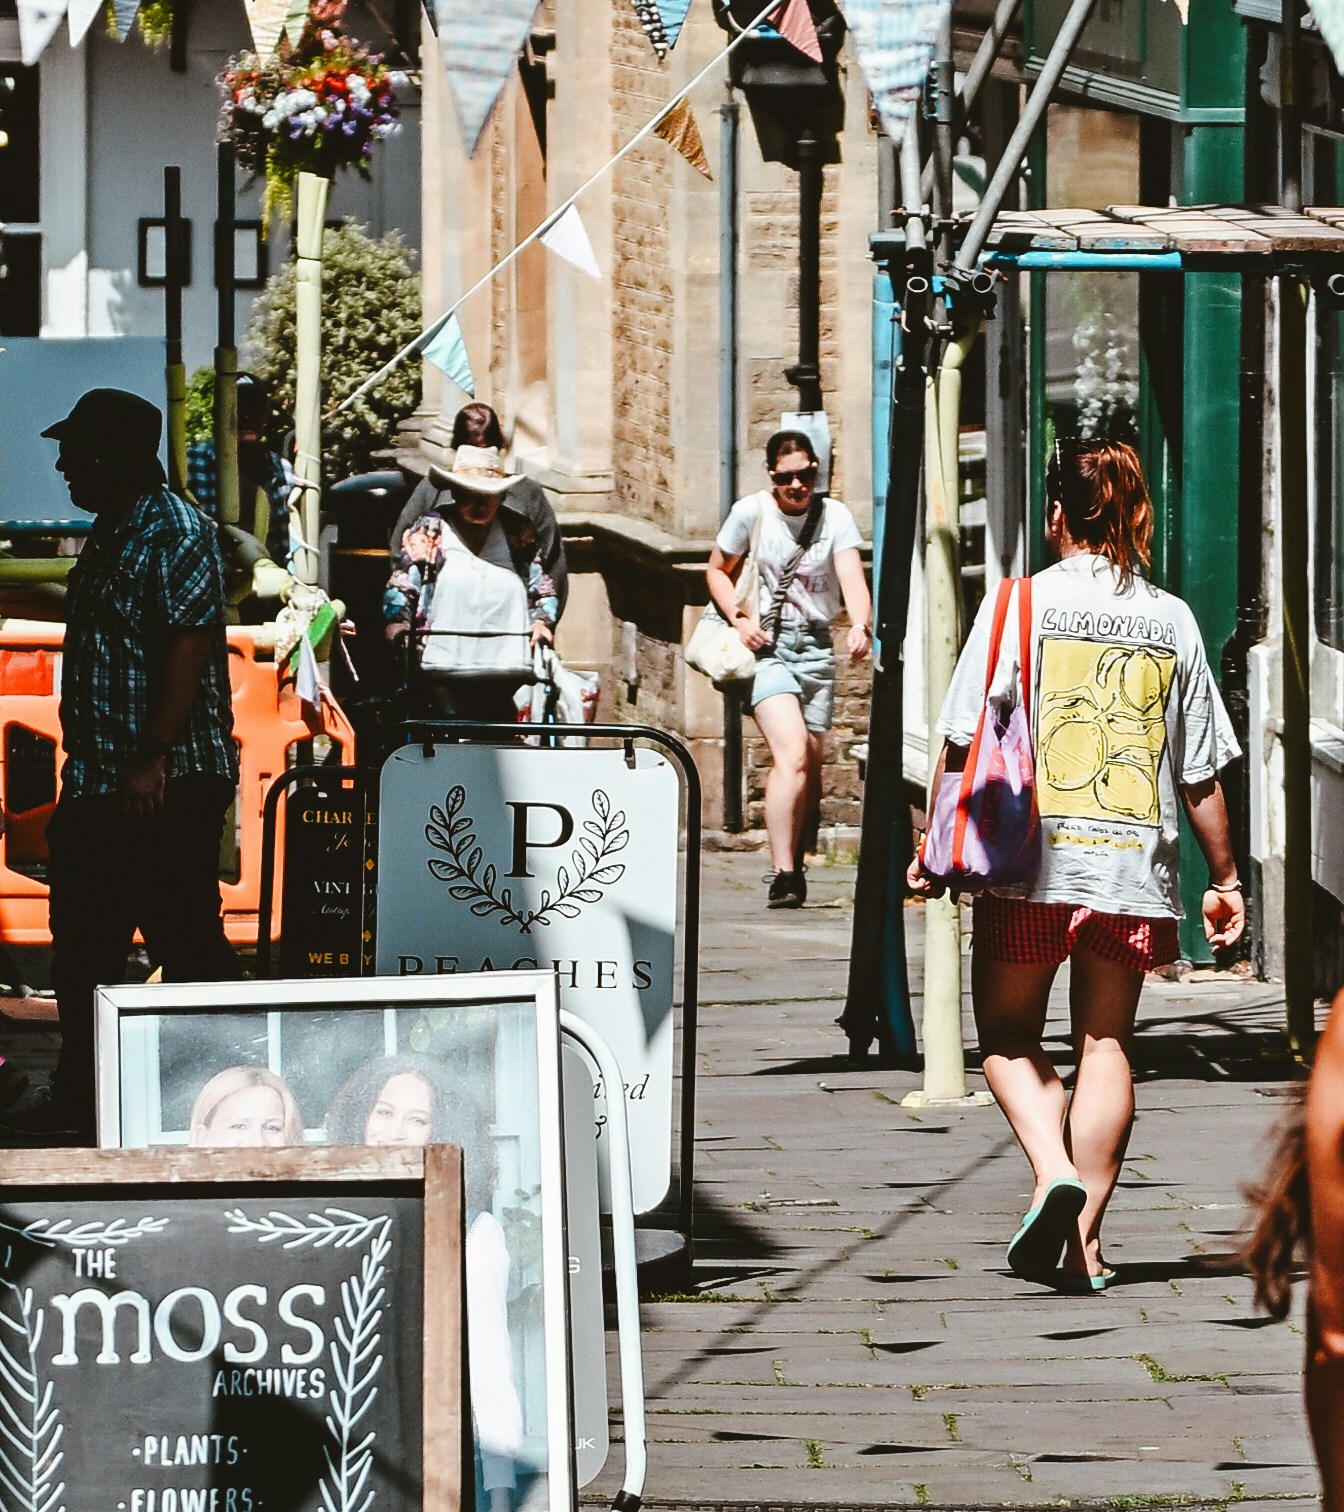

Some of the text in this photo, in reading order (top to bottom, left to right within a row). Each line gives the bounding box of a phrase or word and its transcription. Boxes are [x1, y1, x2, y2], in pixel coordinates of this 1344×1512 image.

[1041, 608, 1177, 647] LIMONADA
[303, 810, 376, 825] CHARE
[504, 801, 574, 879] P
[308, 952, 374, 966] WE BY
[72, 1248, 116, 1278] THE
[212, 1369, 326, 1398] ARCHIVES
[144, 1434, 239, 1465] PLANTS
